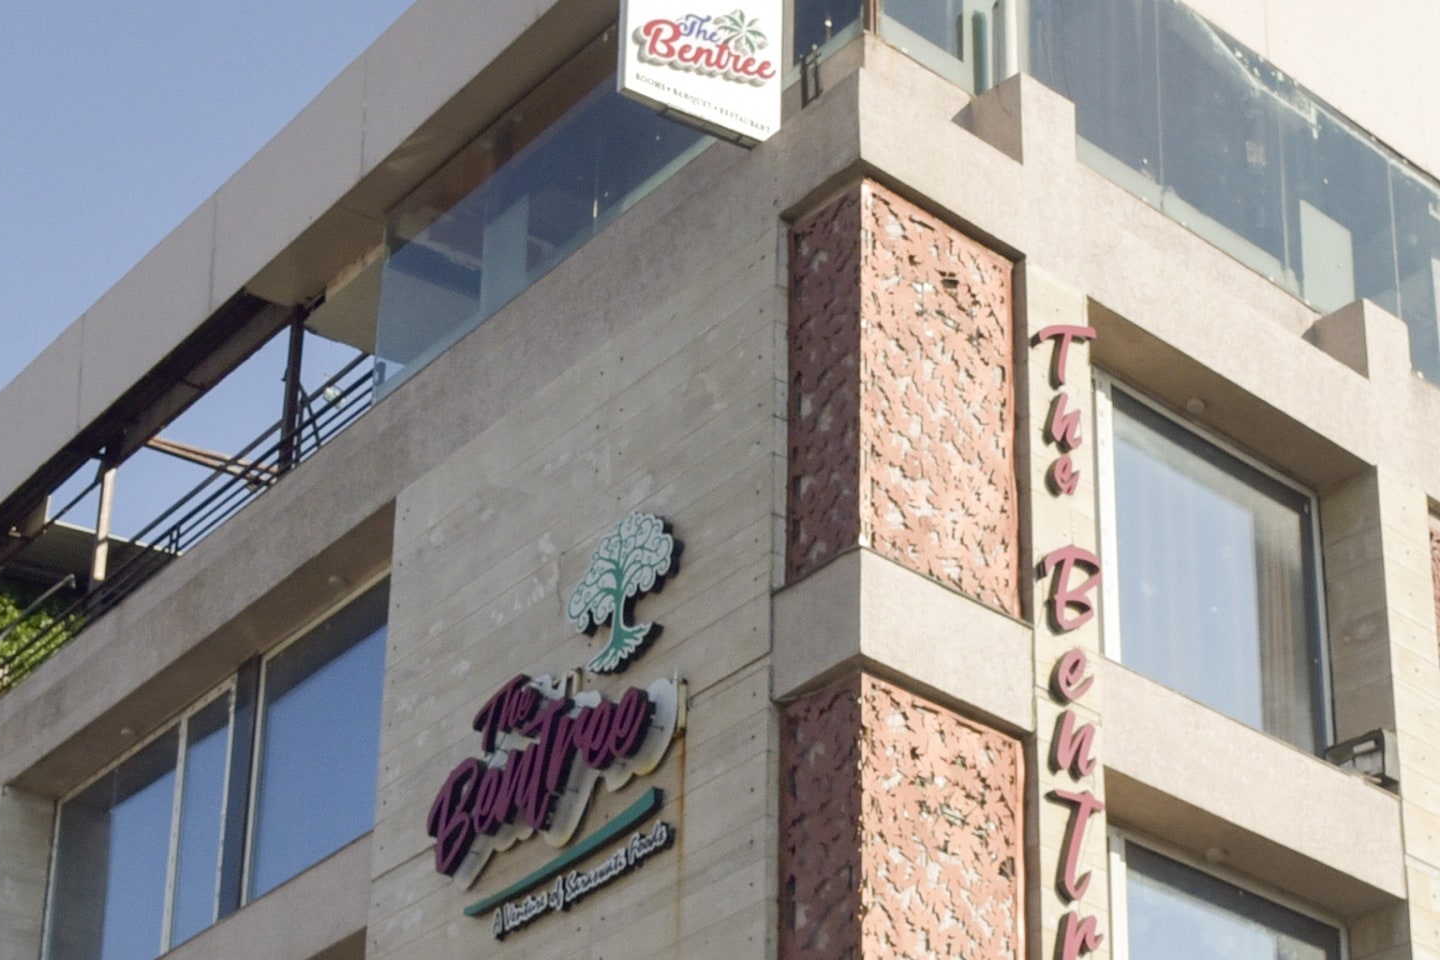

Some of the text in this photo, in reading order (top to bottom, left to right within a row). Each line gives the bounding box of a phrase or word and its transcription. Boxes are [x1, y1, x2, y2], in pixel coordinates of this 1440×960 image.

[643, 19, 776, 79] Bentree
[678, 14, 720, 43] The
[1031, 325, 1097, 497] The
[474, 673, 538, 752] The
[549, 875, 564, 910] of
